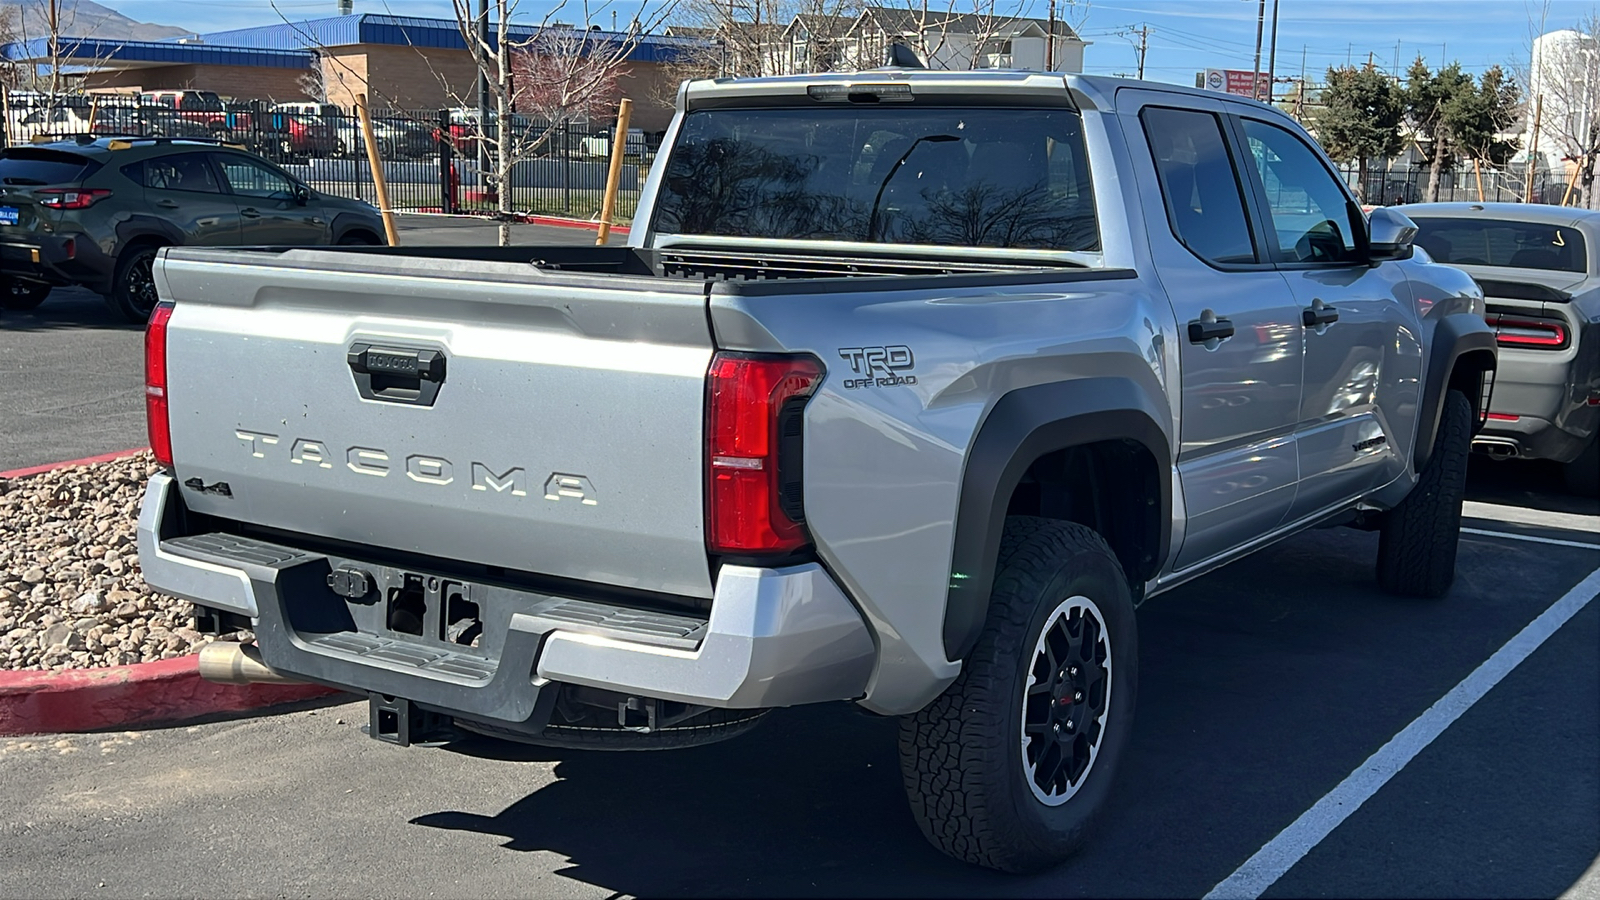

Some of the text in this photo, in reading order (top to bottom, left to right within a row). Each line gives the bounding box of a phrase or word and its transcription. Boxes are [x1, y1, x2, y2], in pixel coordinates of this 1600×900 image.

[369, 354, 415, 370] TOYOTA
[838, 345, 914, 377] TRD
[843, 376, 918, 389] OFF ROAD
[235, 429, 598, 506] TACOMA
